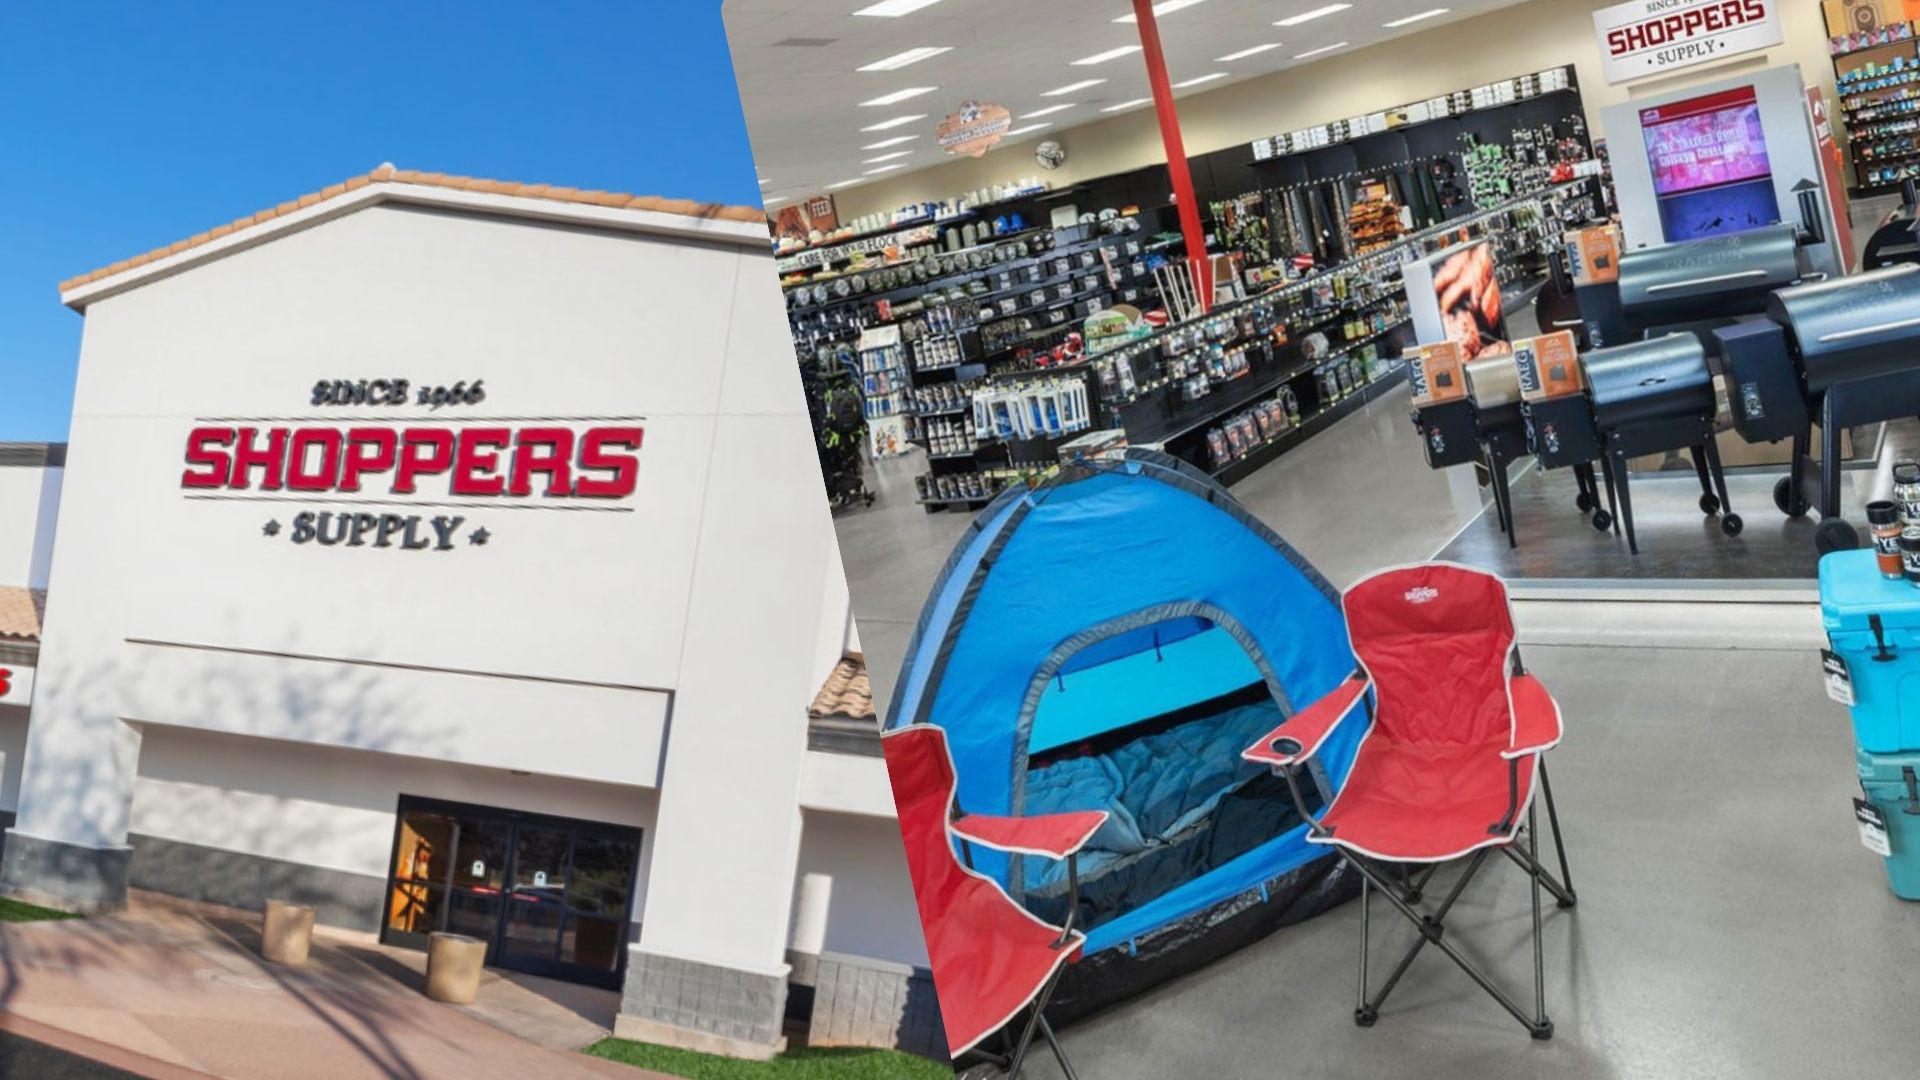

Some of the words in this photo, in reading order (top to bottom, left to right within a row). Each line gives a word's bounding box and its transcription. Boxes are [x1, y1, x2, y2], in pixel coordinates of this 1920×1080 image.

[1606, 0, 1766, 57] SHOPPERS
[1657, 39, 1715, 65] SUPPLY
[799, 251, 820, 265] CARE
[310, 378, 410, 407] SINCE
[415, 378, 486, 411] 1966
[181, 426, 645, 498] SHOPPERS
[290, 511, 466, 551] SUPPLY
